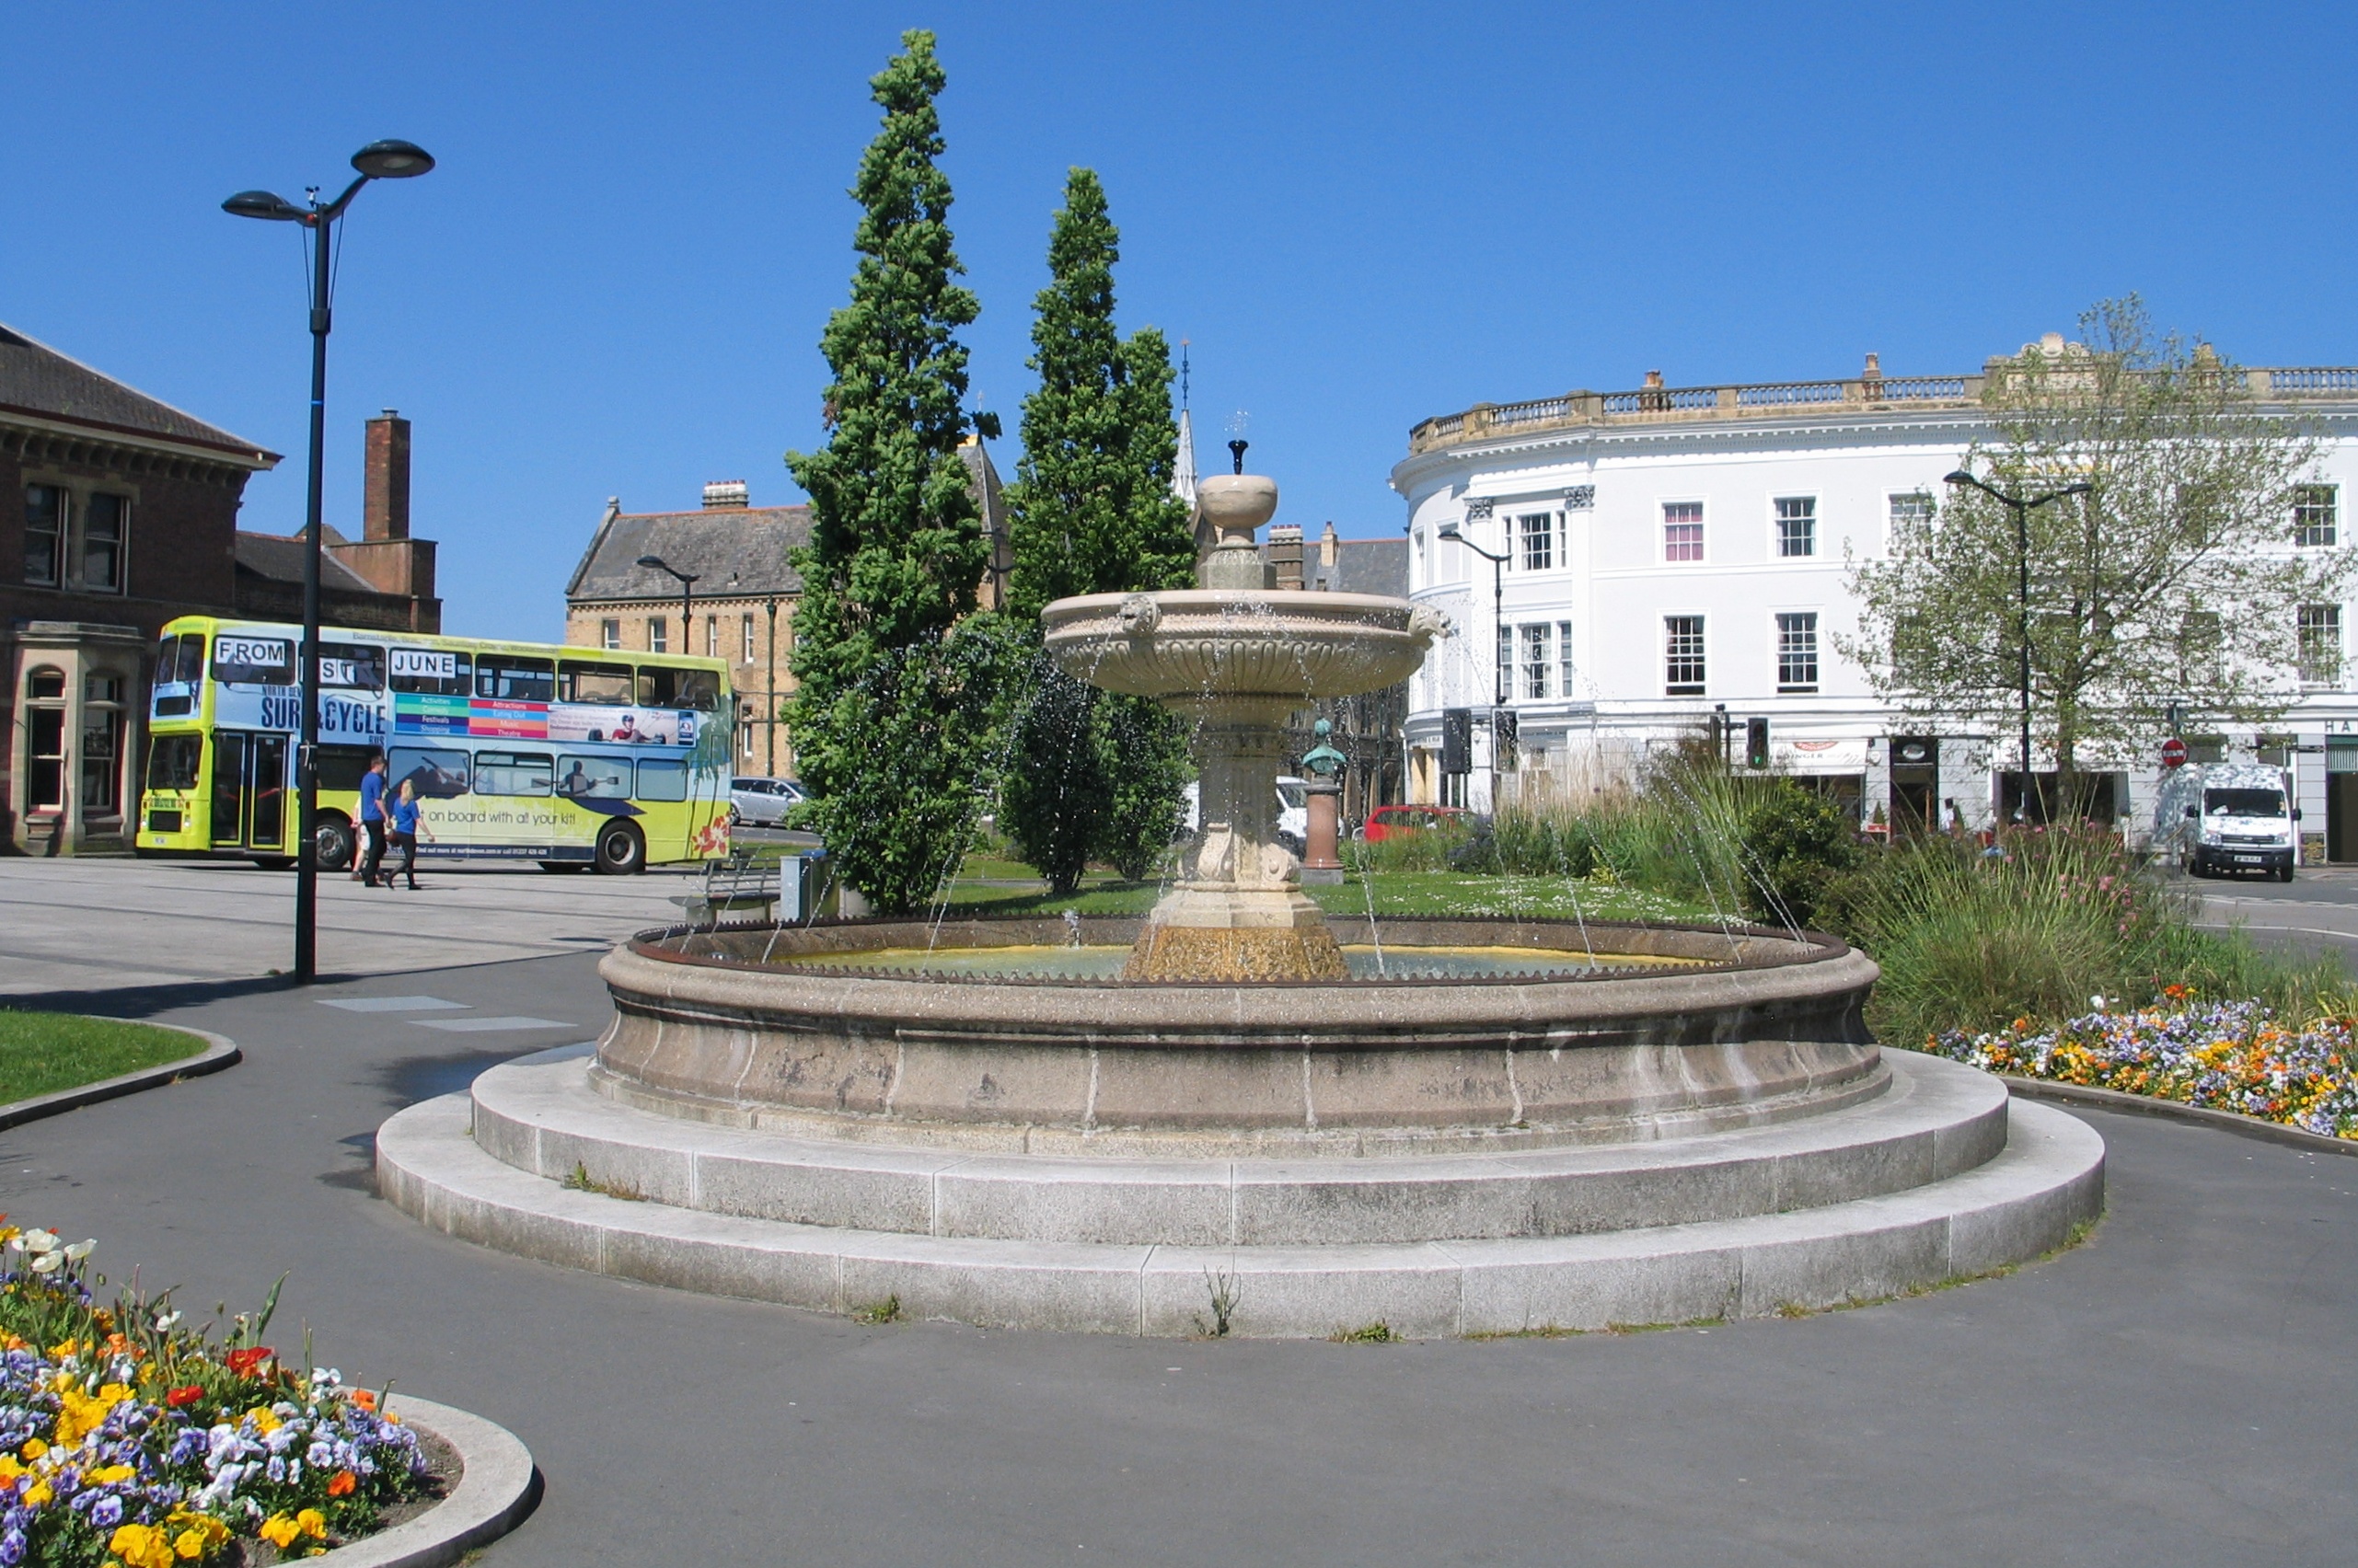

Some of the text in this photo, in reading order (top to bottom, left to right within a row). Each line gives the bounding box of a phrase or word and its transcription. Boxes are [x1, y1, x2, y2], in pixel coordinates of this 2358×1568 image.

[219, 641, 284, 662] FROM
[394, 653, 453, 673] JUNE
[262, 685, 286, 697] NORTH
[422, 697, 450, 705] Activities
[492, 701, 526, 709] Attractions
[261, 698, 300, 729] SUR
[493, 709, 512, 719] Eating
[422, 715, 449, 724] Festivals
[421, 724, 450, 733] Shopping
[429, 811, 445, 822] on
[448, 810, 486, 823] board
[489, 812, 513, 824] with
[516, 813, 529, 824] all
[533, 814, 558, 825] your
[561, 813, 576, 824] kit!
